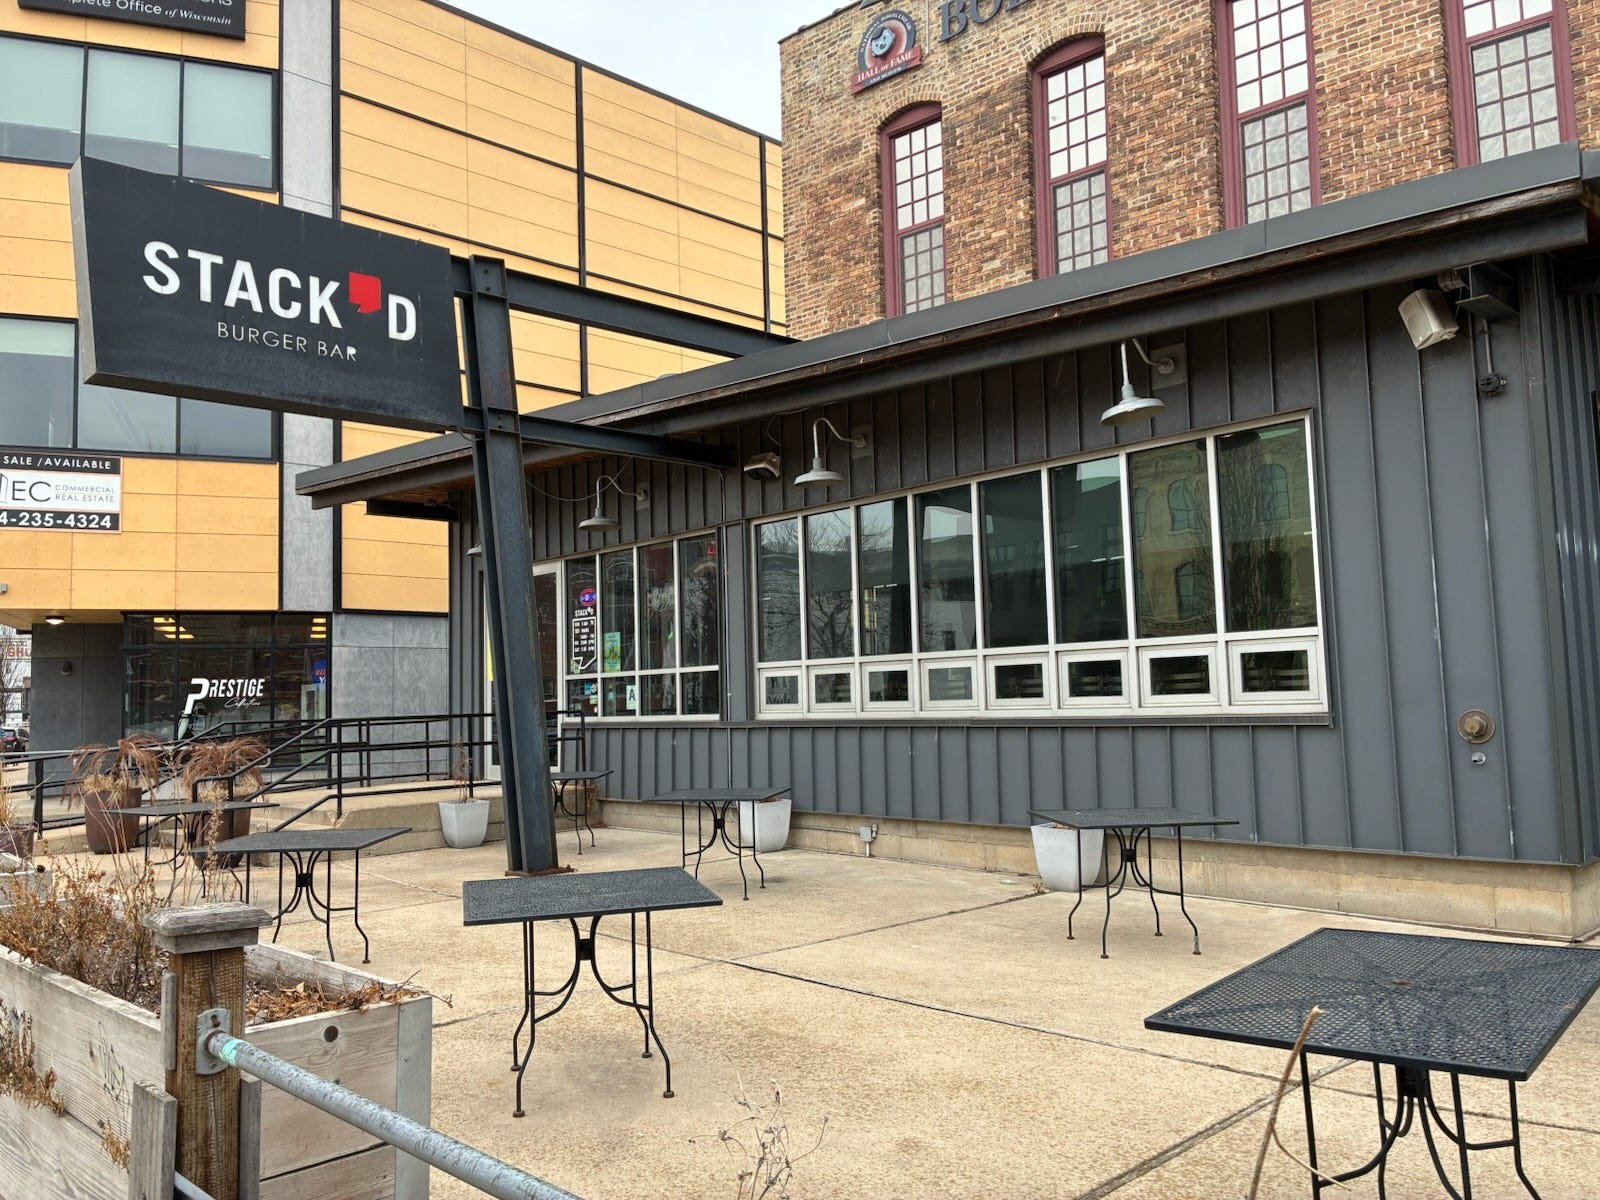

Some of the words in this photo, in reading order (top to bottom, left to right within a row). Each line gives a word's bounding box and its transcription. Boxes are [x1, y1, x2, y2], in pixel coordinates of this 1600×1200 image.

[116, 0, 162, 14] Office
[165, 9, 178, 18] of
[180, 9, 232, 25] Wisconsin
[857, 66, 879, 82] HALL
[890, 50, 914, 67] FAME
[143, 240, 418, 342] STACK'D
[217, 321, 307, 353] BURGER
[317, 340, 358, 362] BAR
[3, 455, 32, 465] SALE
[55, 484, 115, 493] COMMERCIAL
[55, 494, 80, 502] REAL
[83, 495, 115, 503] ESTATE
[0, 511, 112, 528] 4-235-4324
[628, 688, 636, 701] A
